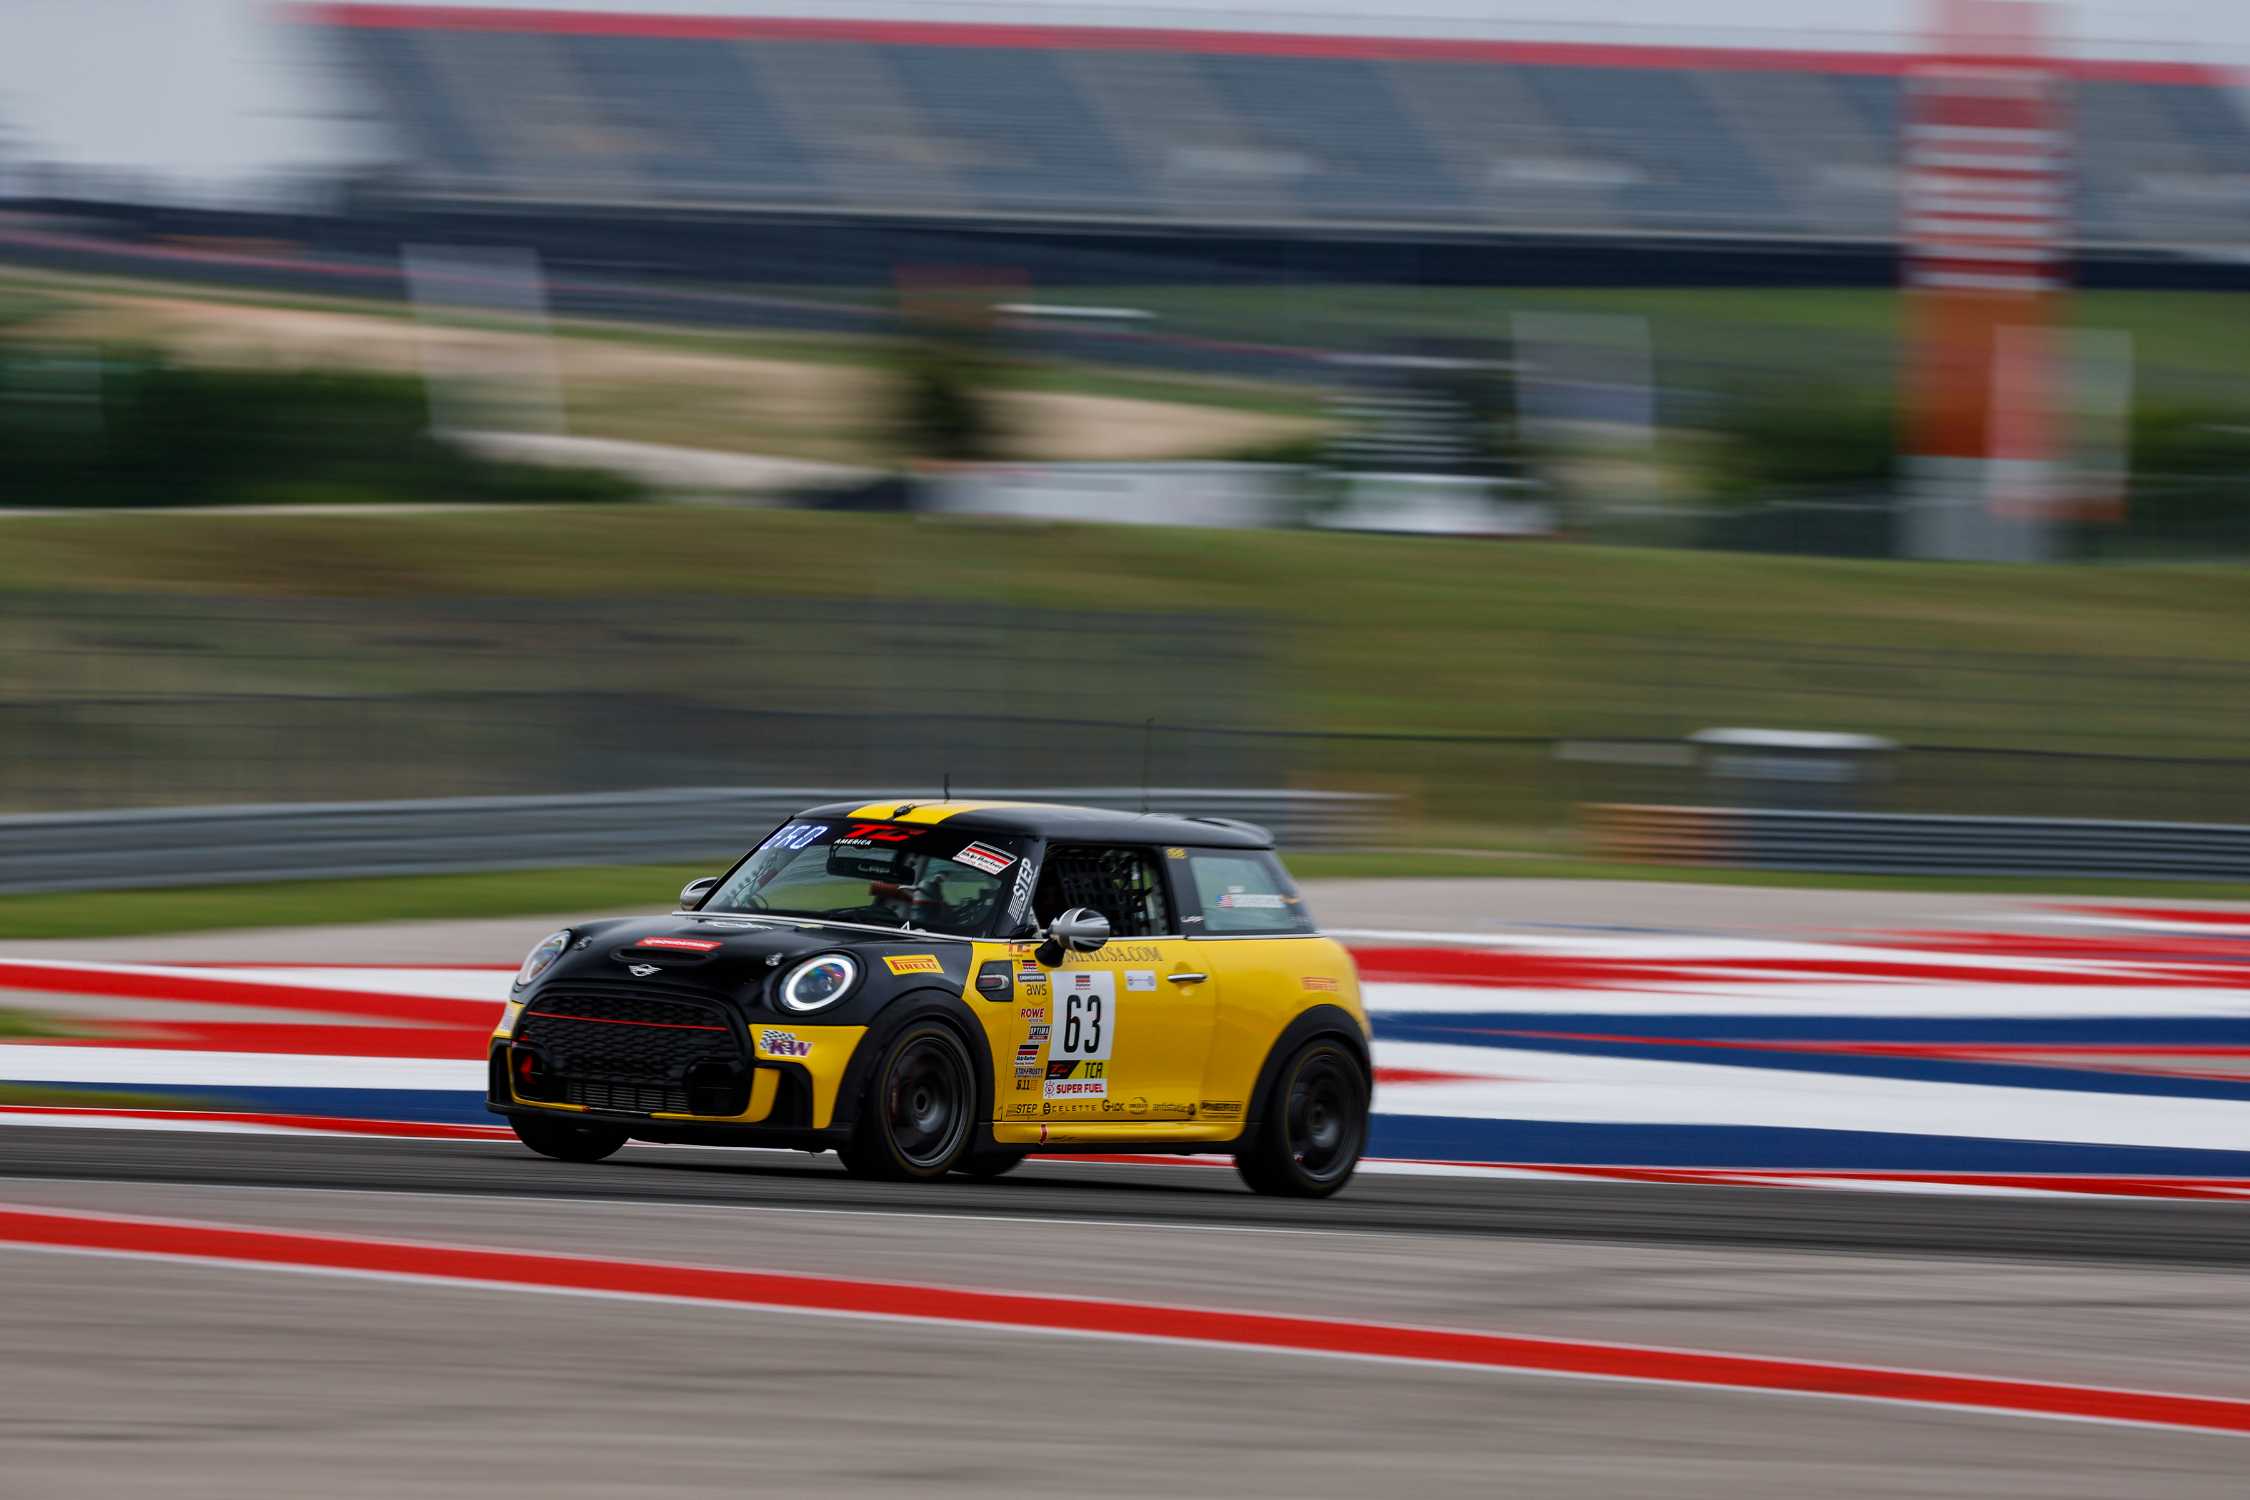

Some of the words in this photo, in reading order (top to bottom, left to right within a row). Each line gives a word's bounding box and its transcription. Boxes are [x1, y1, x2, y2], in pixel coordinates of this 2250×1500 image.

[833, 838, 872, 846] AMERICA
[1013, 858, 1034, 901] STEP
[890, 959, 937, 970] PIRELLI
[1026, 984, 1047, 996] aws
[1020, 1007, 1045, 1019] ROWE
[1063, 994, 1102, 1054] 63
[1056, 1084, 1082, 1094] SUPER
[1084, 1083, 1104, 1093] FUEL
[1016, 1103, 1038, 1114] STEP
[1052, 1104, 1097, 1112] CELETTE
